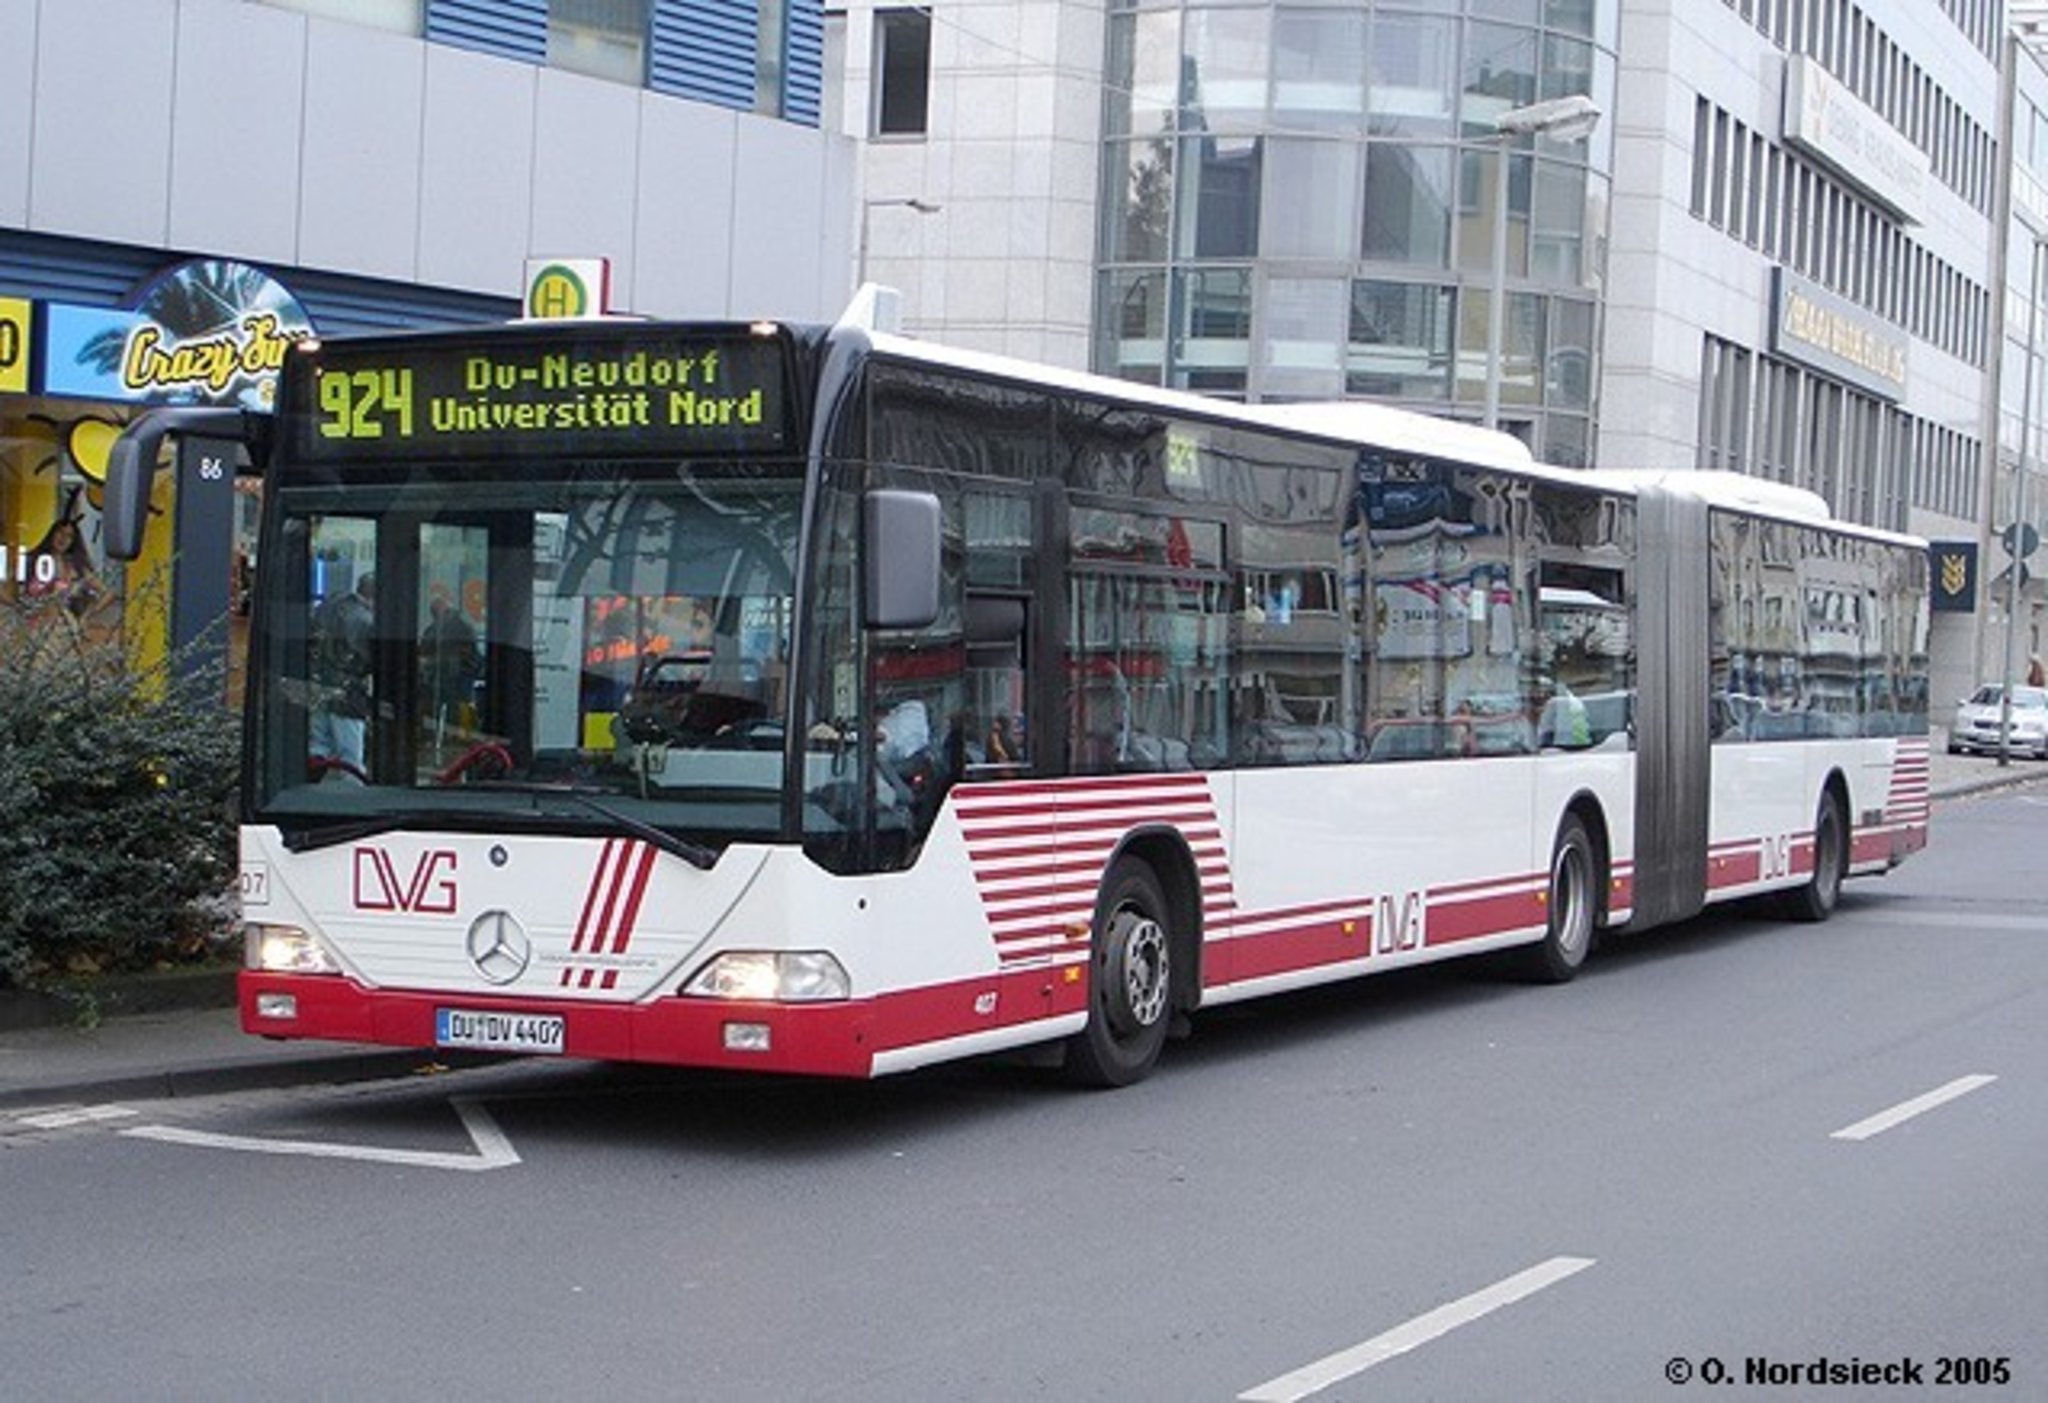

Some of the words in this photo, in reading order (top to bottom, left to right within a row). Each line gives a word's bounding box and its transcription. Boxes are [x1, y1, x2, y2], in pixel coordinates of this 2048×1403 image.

[543, 281, 568, 318] H
[125, 327, 238, 391] Crazy
[319, 368, 413, 438] 924
[431, 394, 650, 431] Universität
[669, 390, 762, 425] Nord
[354, 847, 457, 913] DVG
[1377, 891, 1420, 955] DVG
[452, 1013, 475, 1038] DU
[487, 1016, 512, 1041] DV
[515, 1019, 563, 1044] 4407
